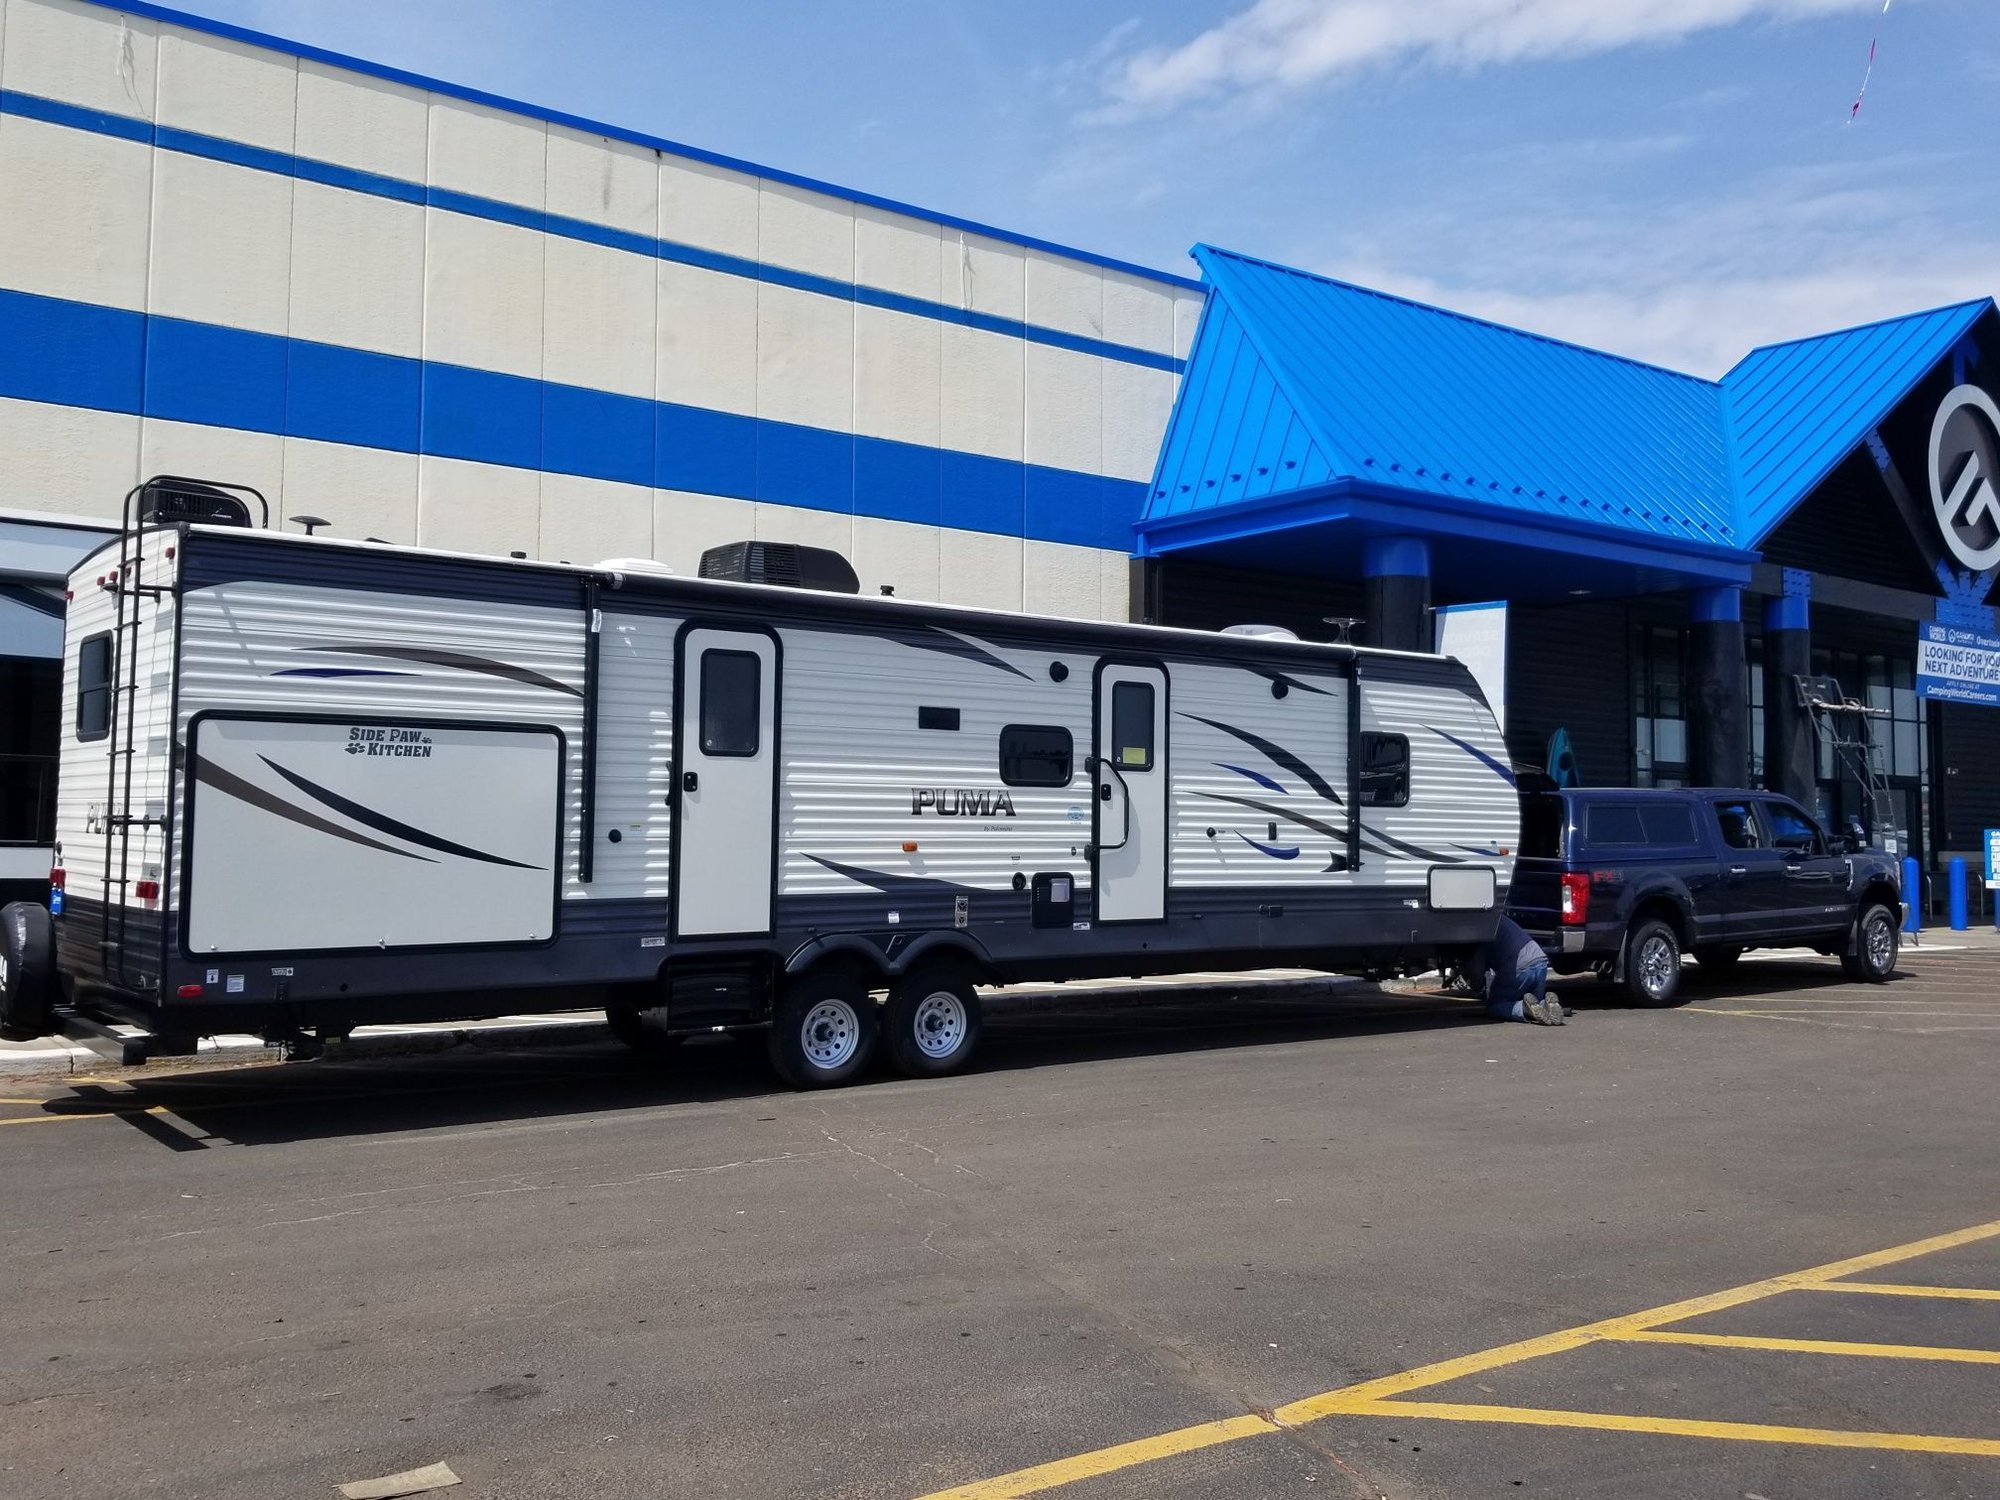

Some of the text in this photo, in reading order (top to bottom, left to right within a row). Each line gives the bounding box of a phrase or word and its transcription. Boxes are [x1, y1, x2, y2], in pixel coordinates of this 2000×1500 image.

[1925, 645, 1963, 662] LOOKING
[1965, 651, 1982, 665] FOR
[1925, 660, 2000, 680] NEXT ADVENTURE
[349, 727, 422, 743] SIDE PAW
[367, 742, 432, 757] KITCHEN
[911, 788, 1017, 816] PUMA
